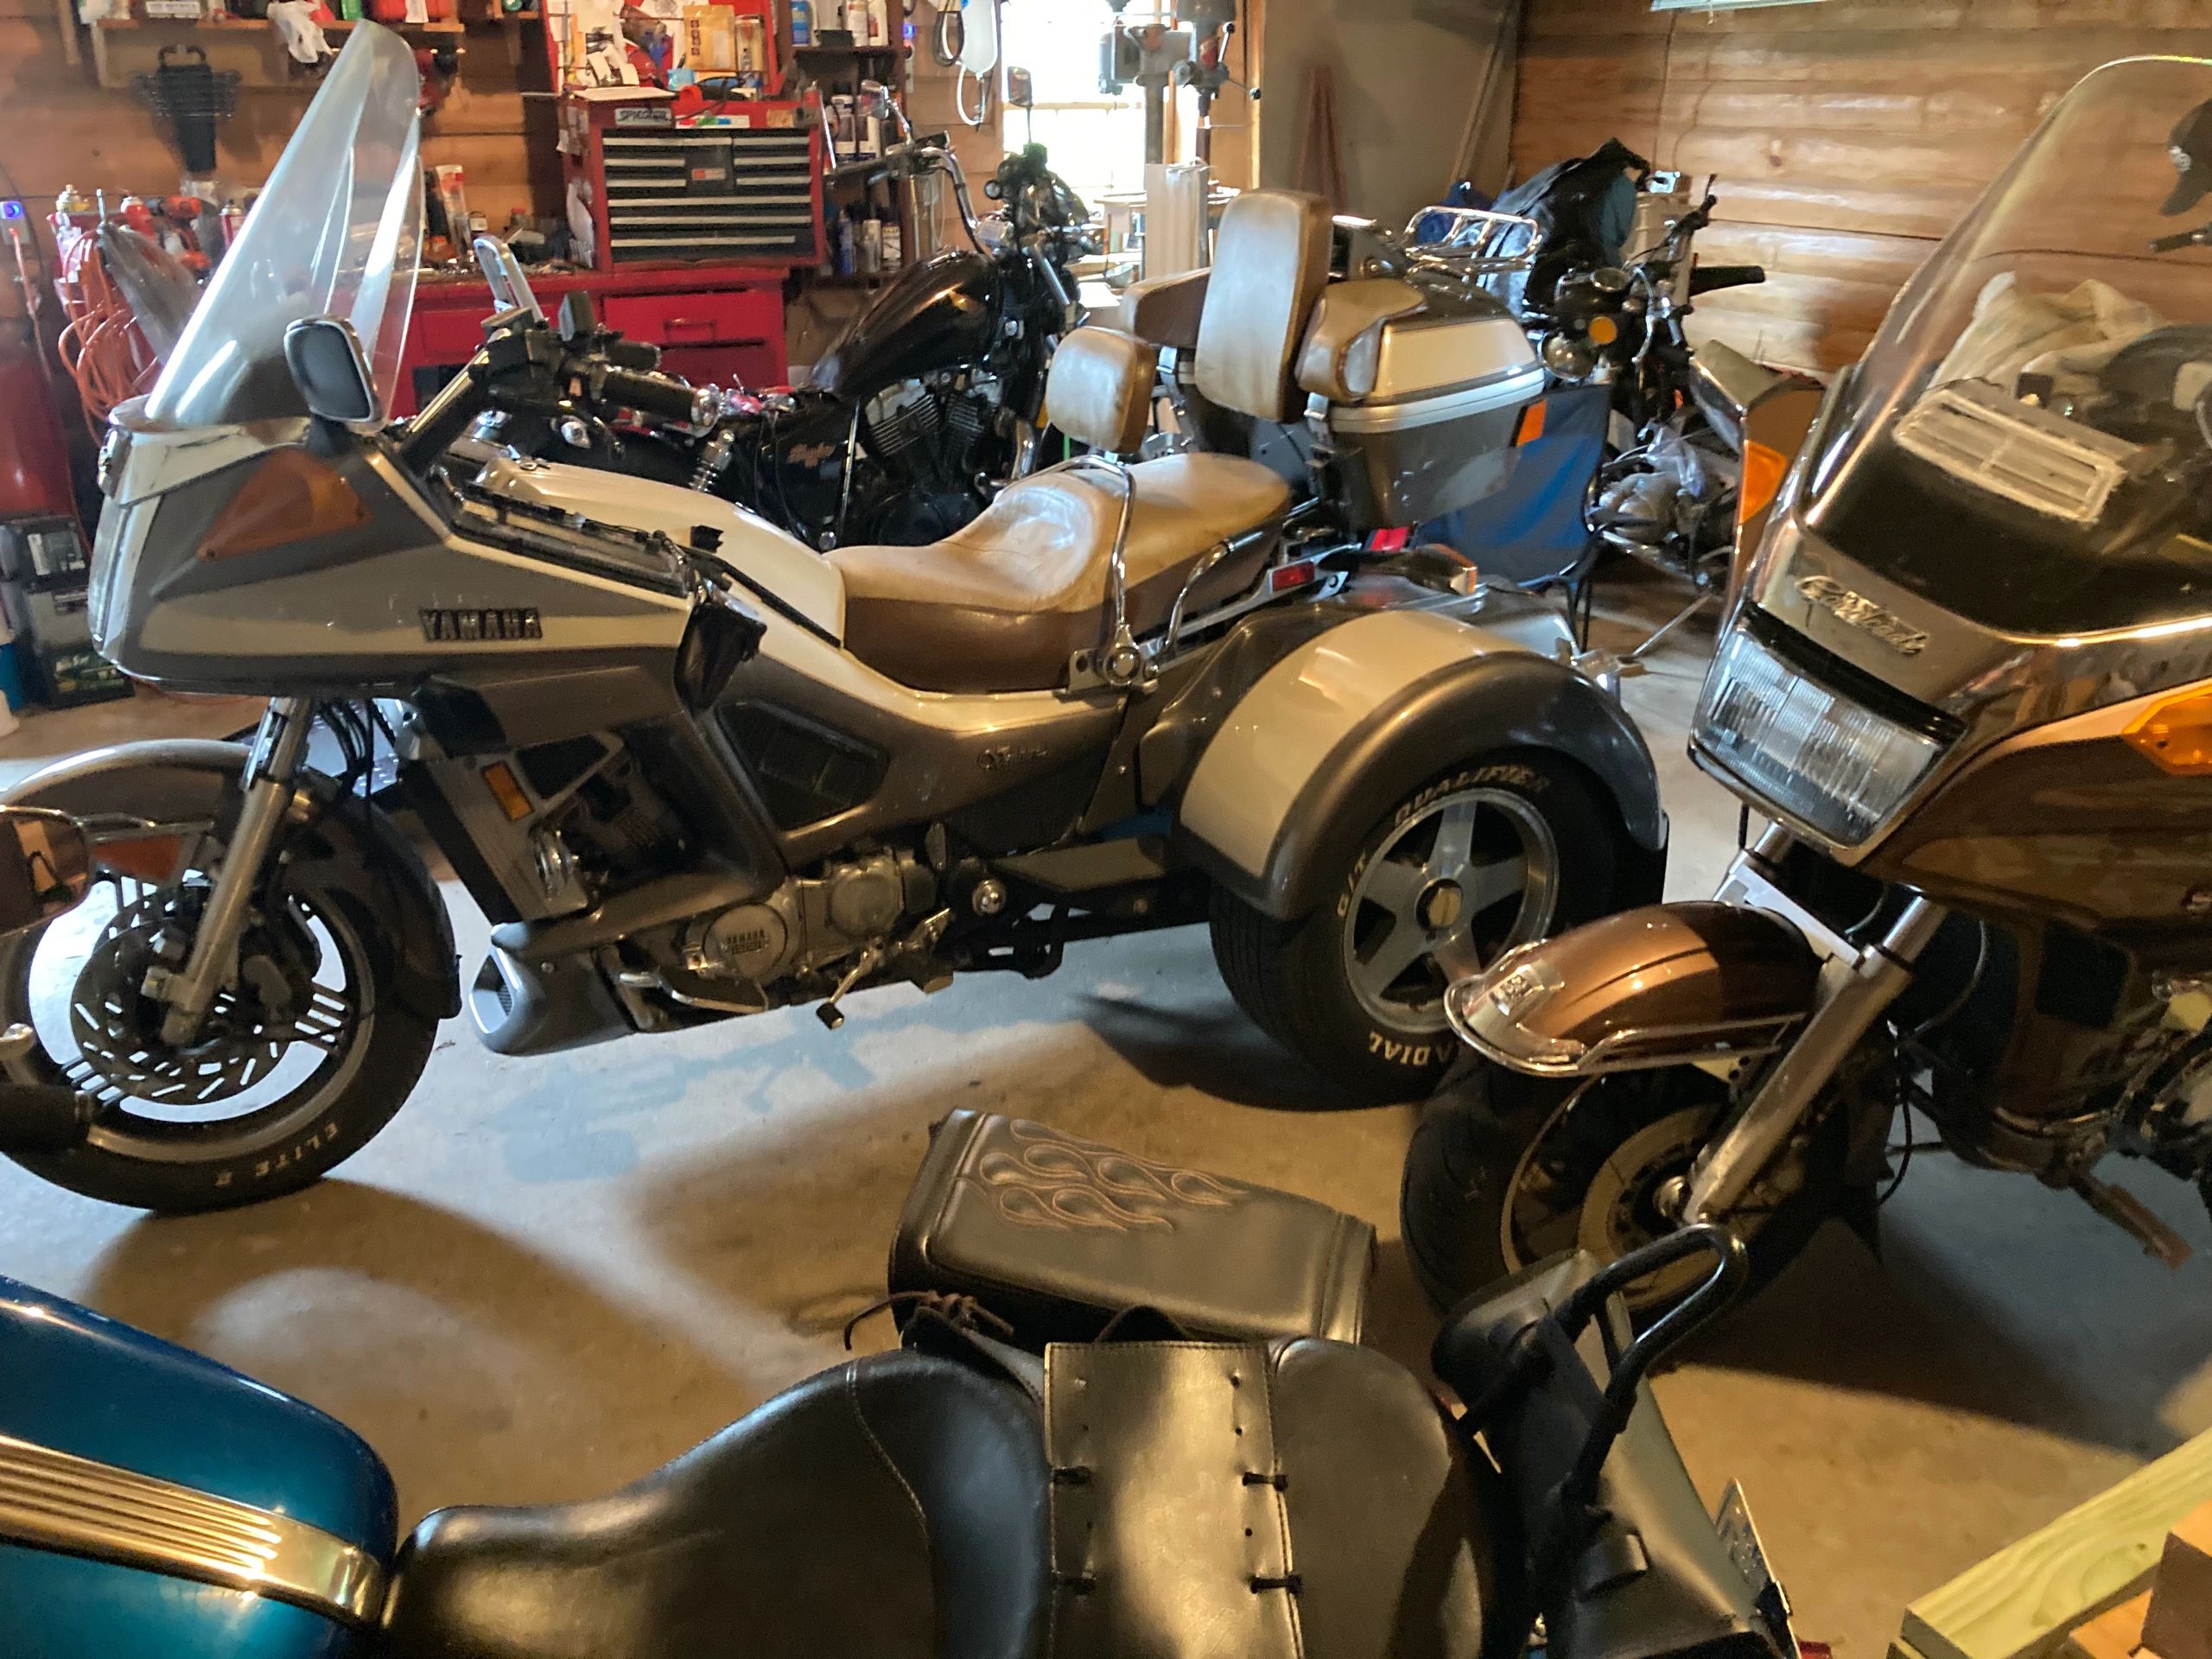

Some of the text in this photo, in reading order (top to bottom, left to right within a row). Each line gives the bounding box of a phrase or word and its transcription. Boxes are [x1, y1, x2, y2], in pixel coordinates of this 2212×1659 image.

[420, 608, 543, 641] YAMAHA
[1395, 765, 1549, 826] QUALIFIER
[1370, 1031, 1453, 1065] ADIAL
[256, 1122, 338, 1177] ELITE
